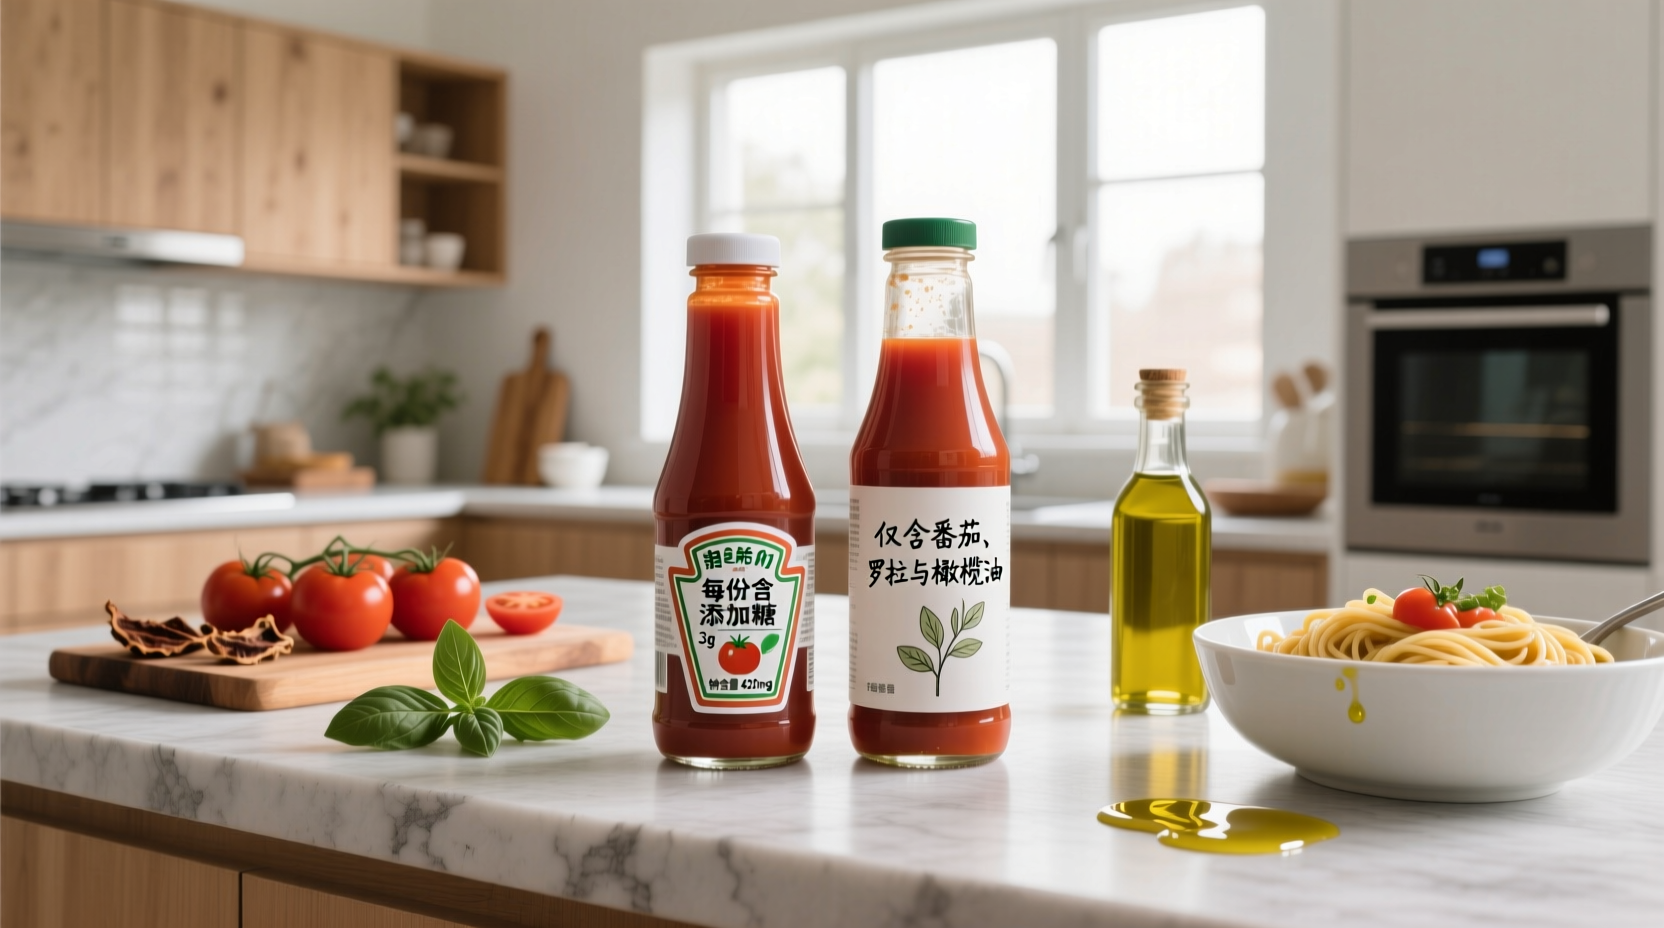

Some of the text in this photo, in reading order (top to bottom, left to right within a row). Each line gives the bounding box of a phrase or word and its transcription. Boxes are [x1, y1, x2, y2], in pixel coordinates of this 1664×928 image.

[874, 518, 990, 550] 仅含番茄、
[868, 556, 1003, 588] 罗拉与橄榄油
[701, 577, 774, 603] 每份含
[699, 603, 777, 627] 添加糖
[698, 631, 715, 649] 3g
